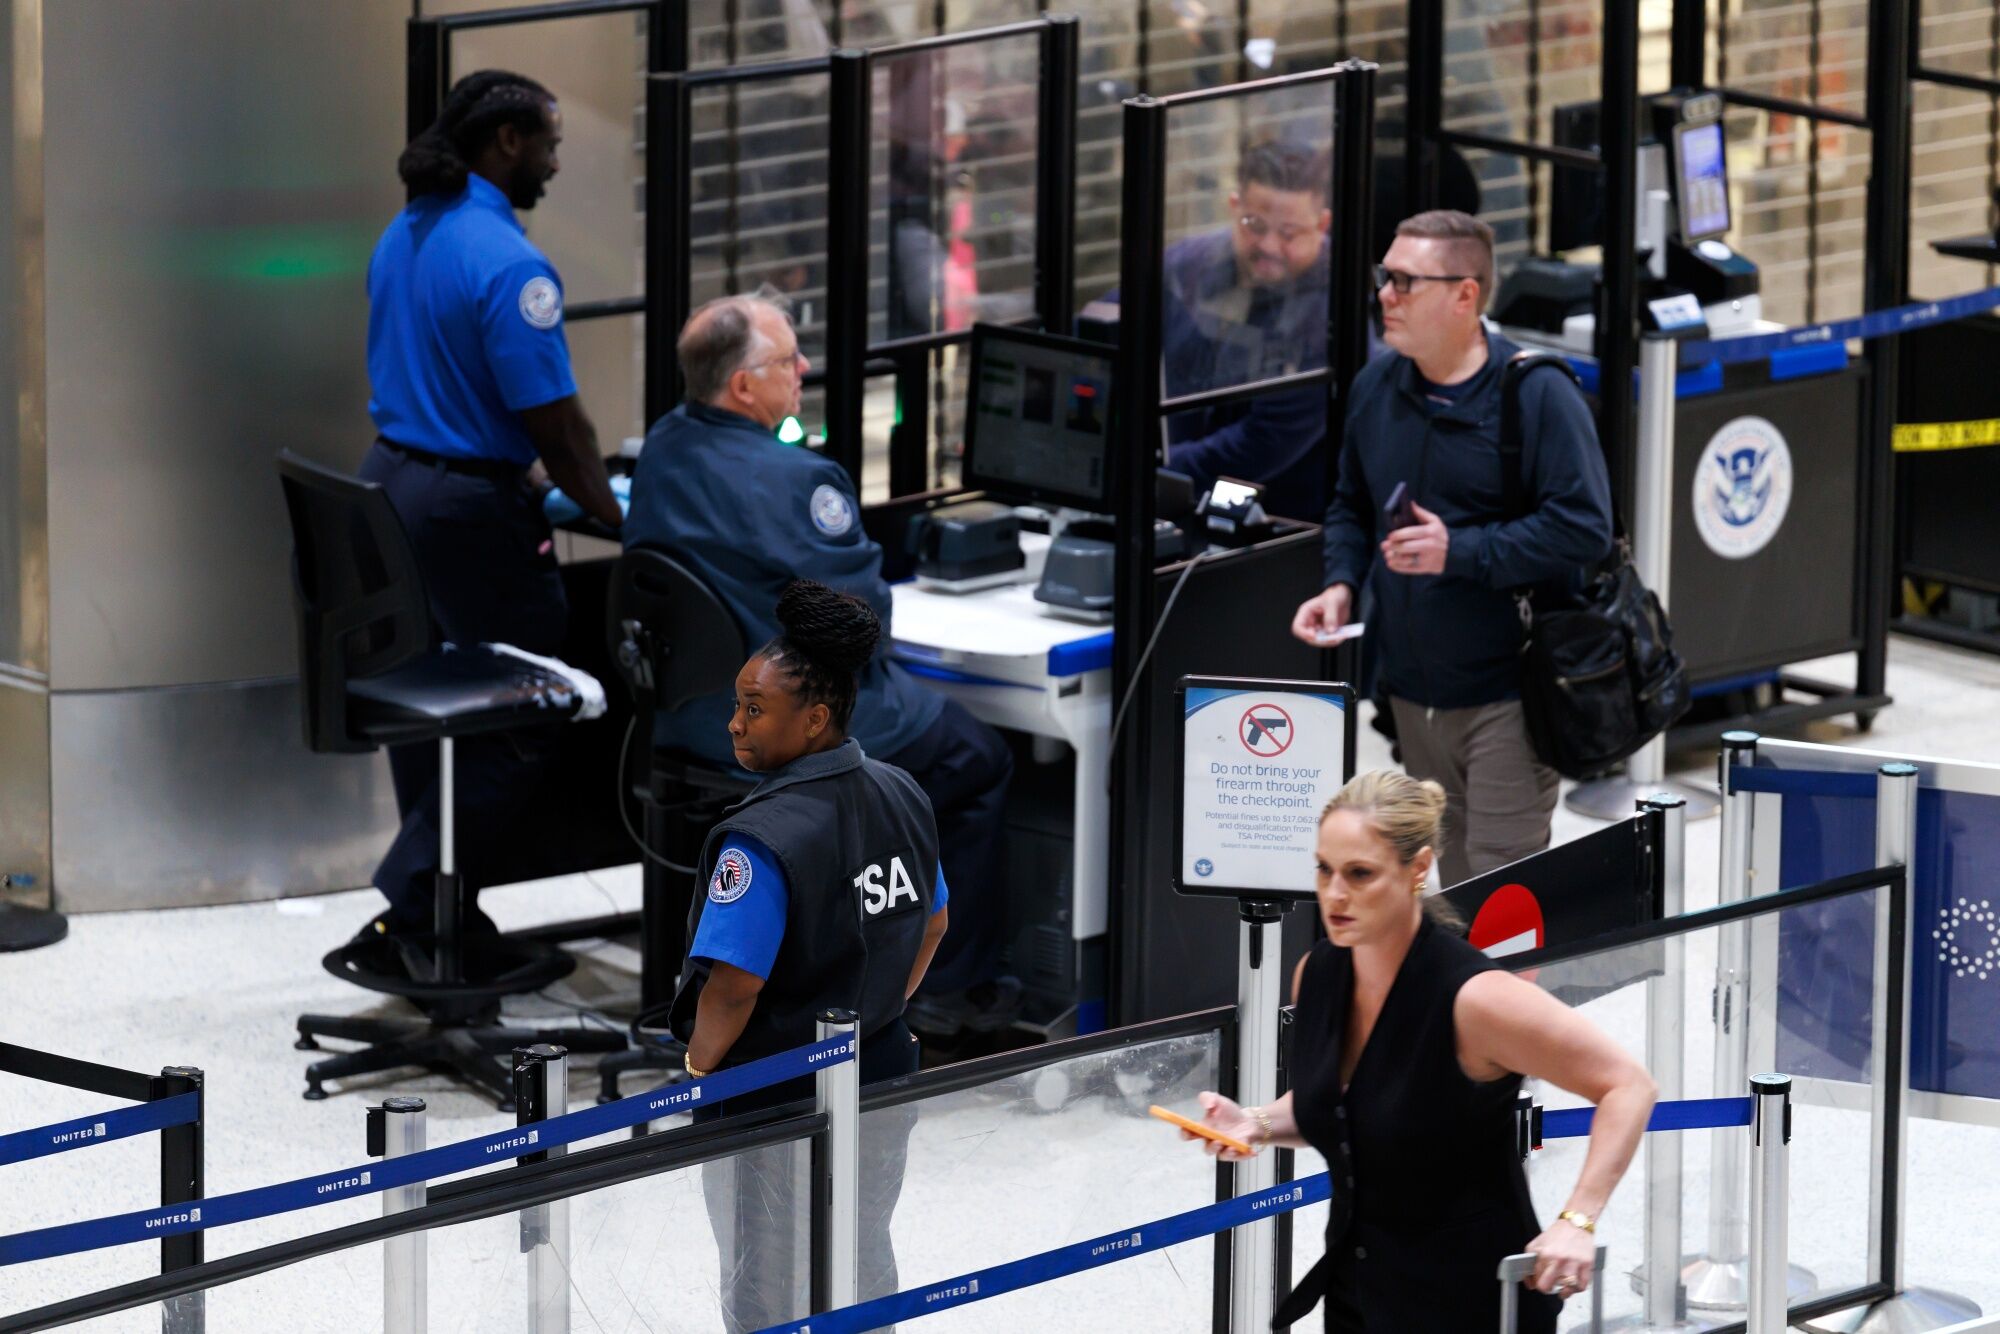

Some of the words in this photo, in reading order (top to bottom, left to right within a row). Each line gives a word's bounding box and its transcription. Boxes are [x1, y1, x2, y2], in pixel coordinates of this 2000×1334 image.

[1211, 762, 1228, 774] Do
[1232, 764, 1252, 775] not
[1256, 764, 1288, 779] bring
[1292, 768, 1321, 780] your
[1216, 777, 1262, 790] firearm
[1266, 780, 1315, 795] through
[1218, 793, 1239, 805] the
[1242, 794, 1313, 809] checkpoint.
[1205, 811, 1239, 820] Potential
[1240, 813, 1259, 821] fines
[1261, 815, 1271, 823] up
[1273, 814, 1281, 822] to
[1218, 822, 1233, 830] and
[1233, 823, 1291, 833] disqualification
[1293, 824, 1312, 833] from
[1238, 832, 1252, 840] TSA
[808, 1045, 847, 1063] UNITED
[650, 1092, 690, 1109] UNITED
[53, 1129, 93, 1144] UNITED
[486, 1136, 527, 1154] UNITED
[317, 1177, 359, 1194] UNITED
[1252, 1193, 1291, 1210] UNITED
[145, 1213, 188, 1228] UNITED
[1092, 1239, 1130, 1256] UNITED
[926, 1286, 967, 1303] UNITED
